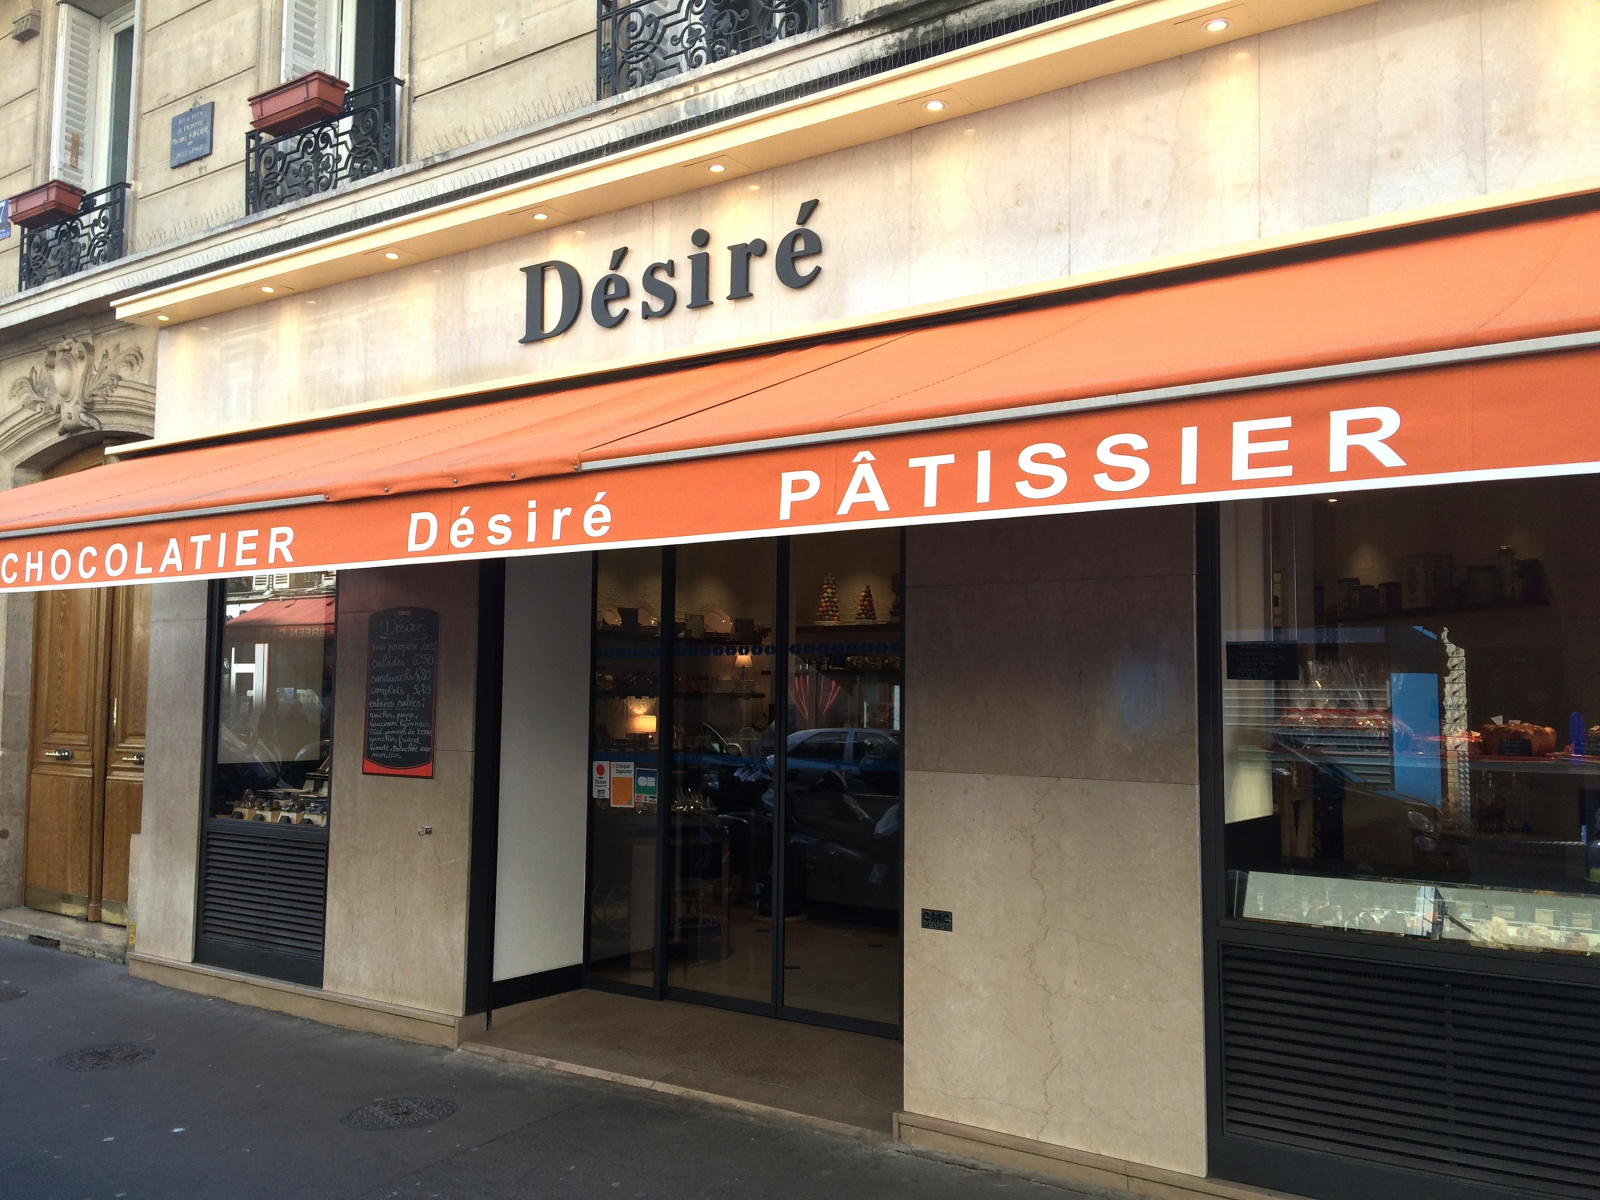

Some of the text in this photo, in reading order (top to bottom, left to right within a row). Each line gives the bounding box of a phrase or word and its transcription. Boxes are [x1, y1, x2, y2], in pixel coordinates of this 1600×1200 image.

[518, 198, 823, 344] Désiré
[0, 405, 1408, 585] CHOCOLATIER Désiré PÂTISSIER
[380, 617, 426, 634] Désiré
[387, 643, 418, 656] propose
[372, 654, 405, 668] salades
